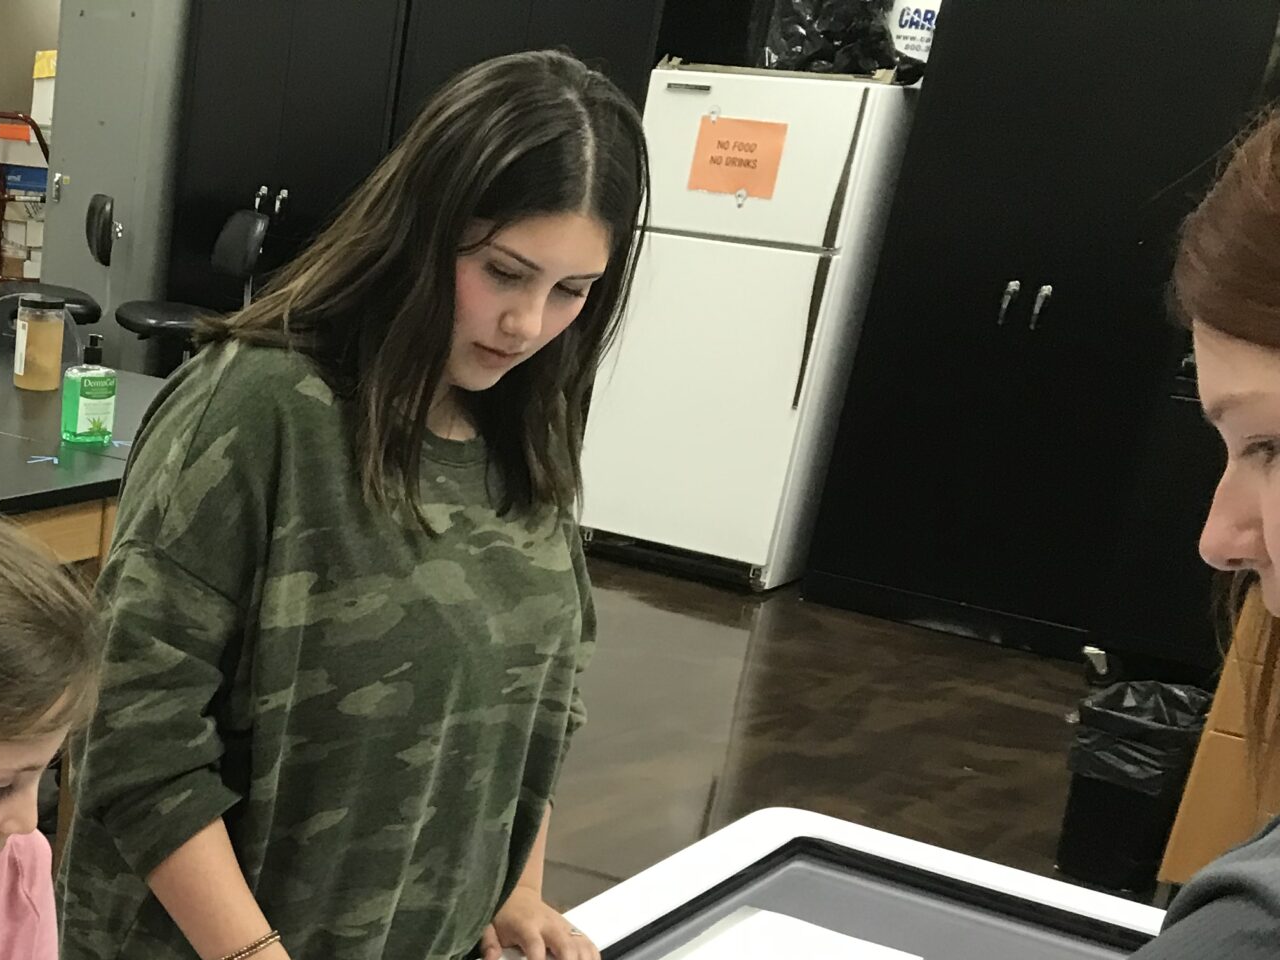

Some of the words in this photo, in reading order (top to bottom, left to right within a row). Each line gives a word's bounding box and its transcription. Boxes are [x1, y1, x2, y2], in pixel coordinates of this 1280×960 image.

[716, 140, 730, 151] NO
[731, 141, 758, 154] FOOD
[709, 155, 723, 166] NO
[724, 156, 758, 170] DRINKS
